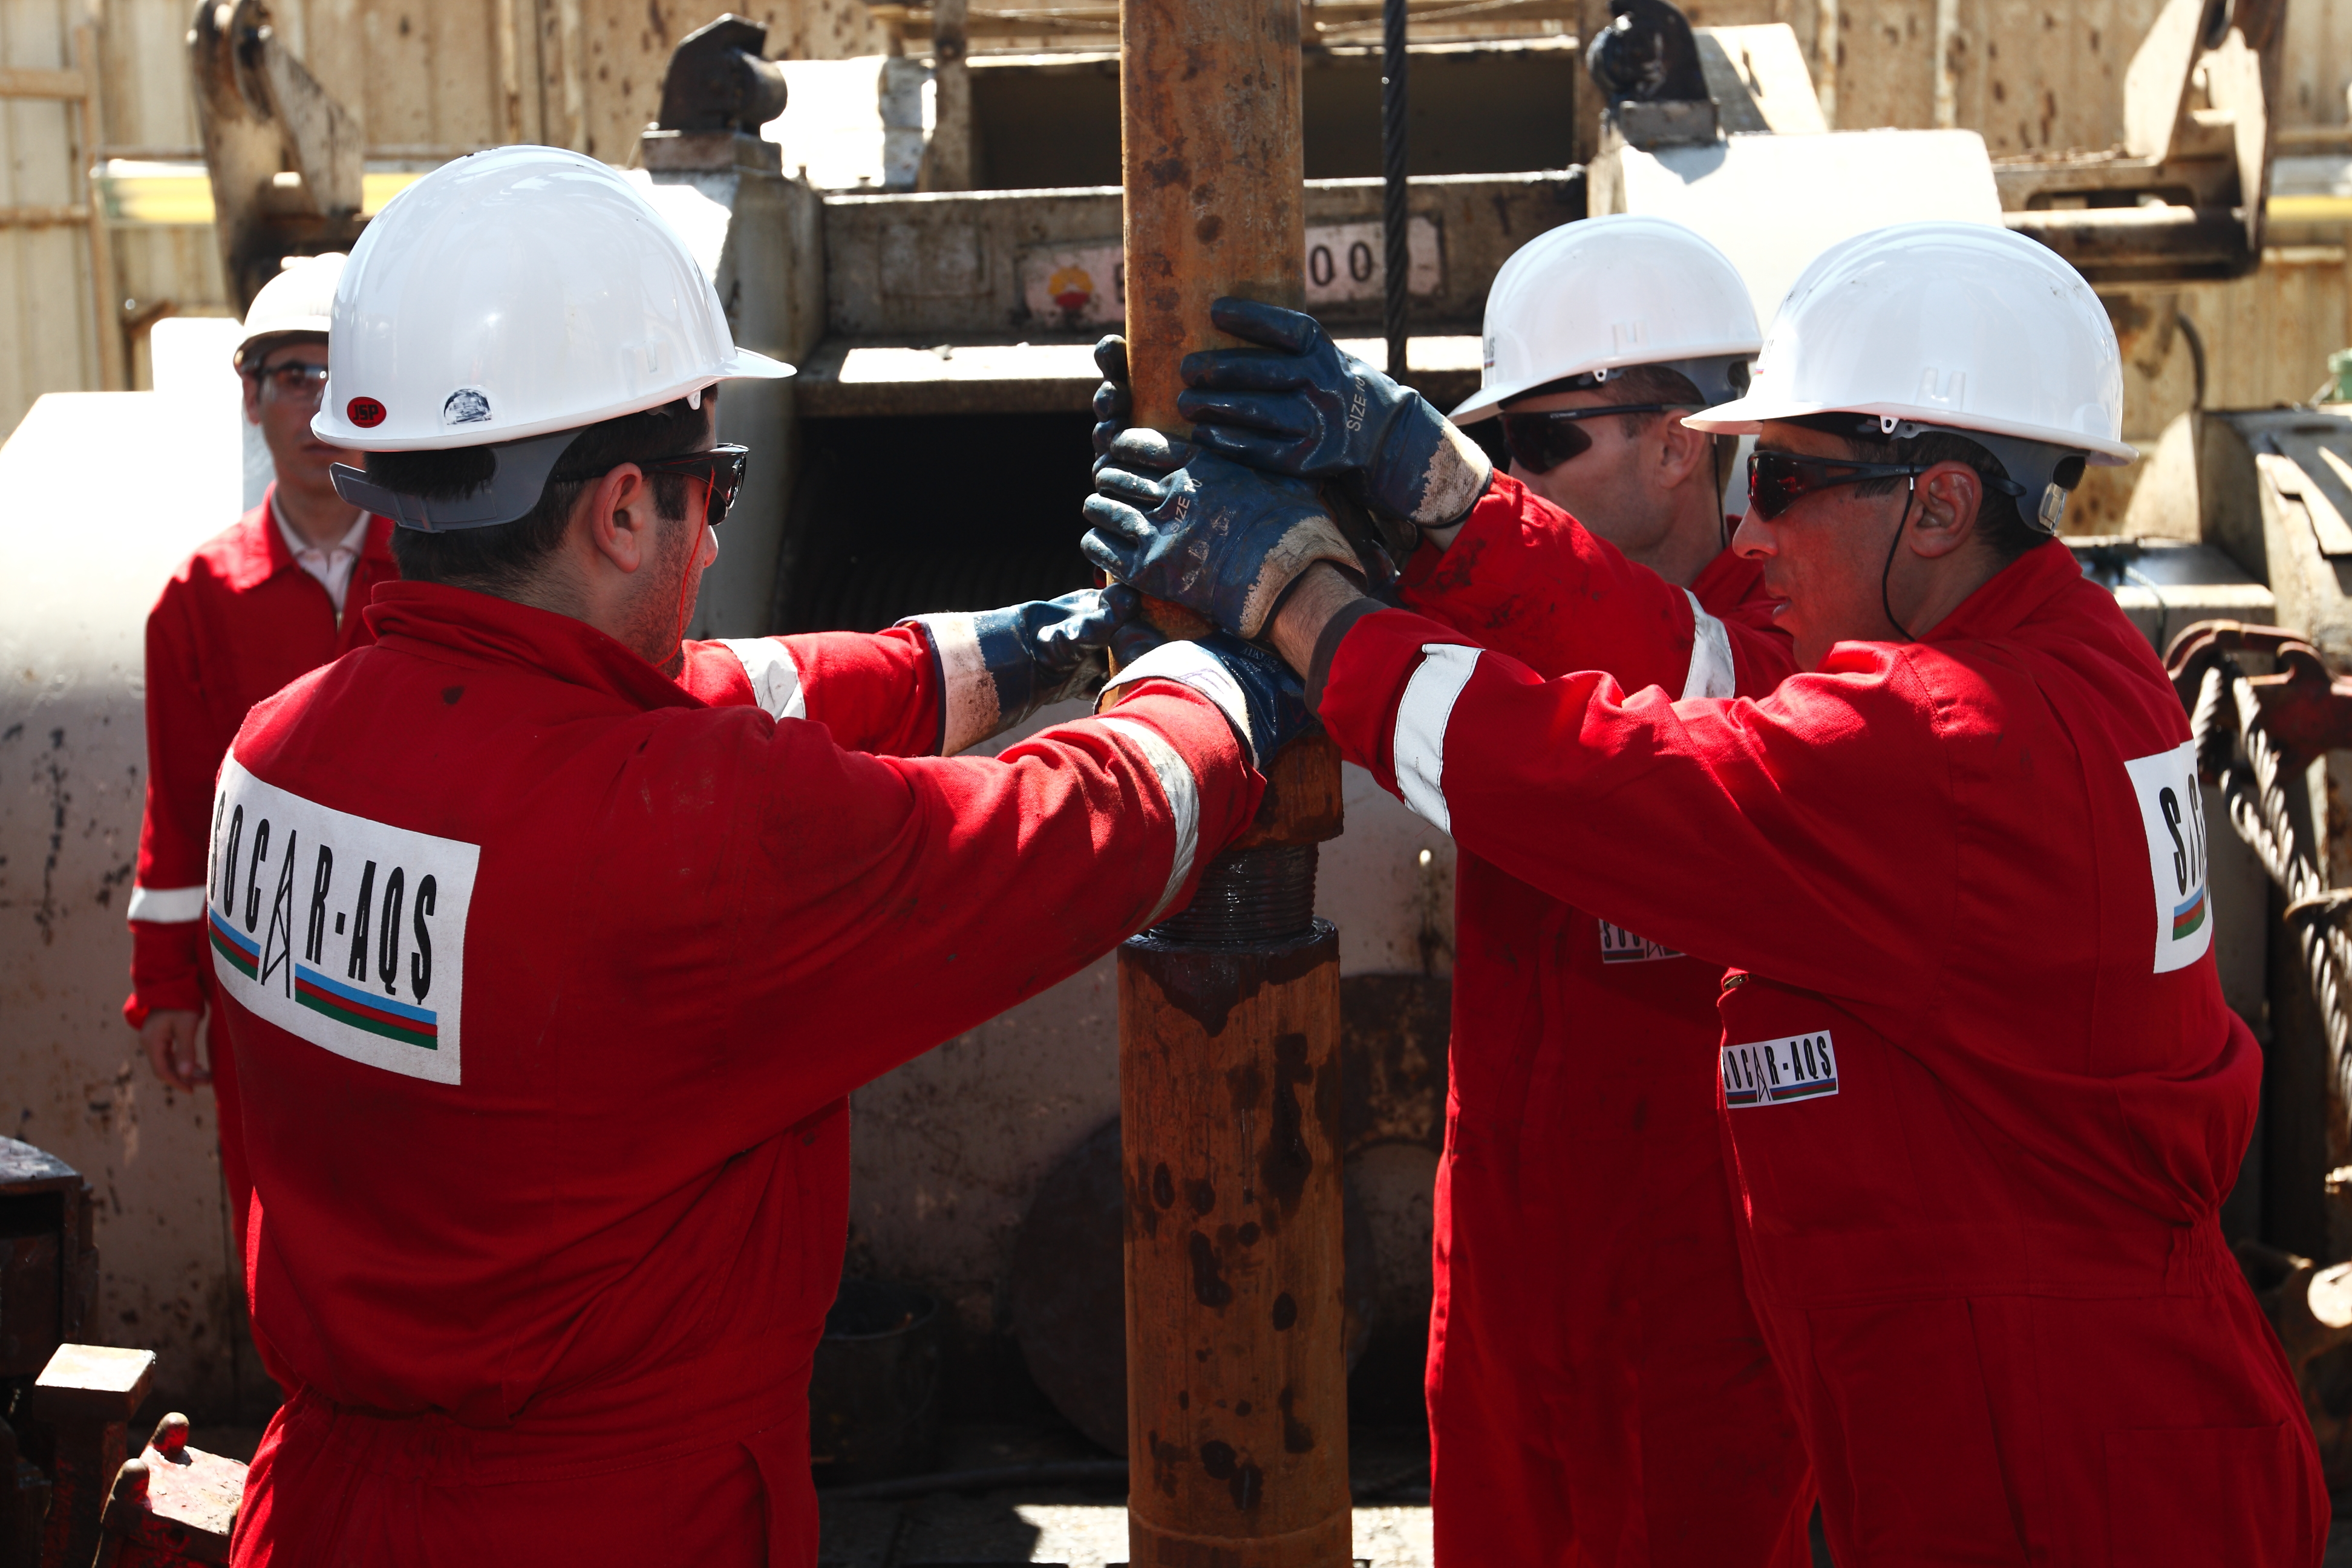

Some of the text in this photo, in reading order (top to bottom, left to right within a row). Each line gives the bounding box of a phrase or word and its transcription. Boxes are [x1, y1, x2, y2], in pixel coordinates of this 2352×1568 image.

[353, 404, 379, 420] JSP
[1346, 376, 1367, 431] SIZE 10
[1171, 479, 1203, 533] SIZE 10
